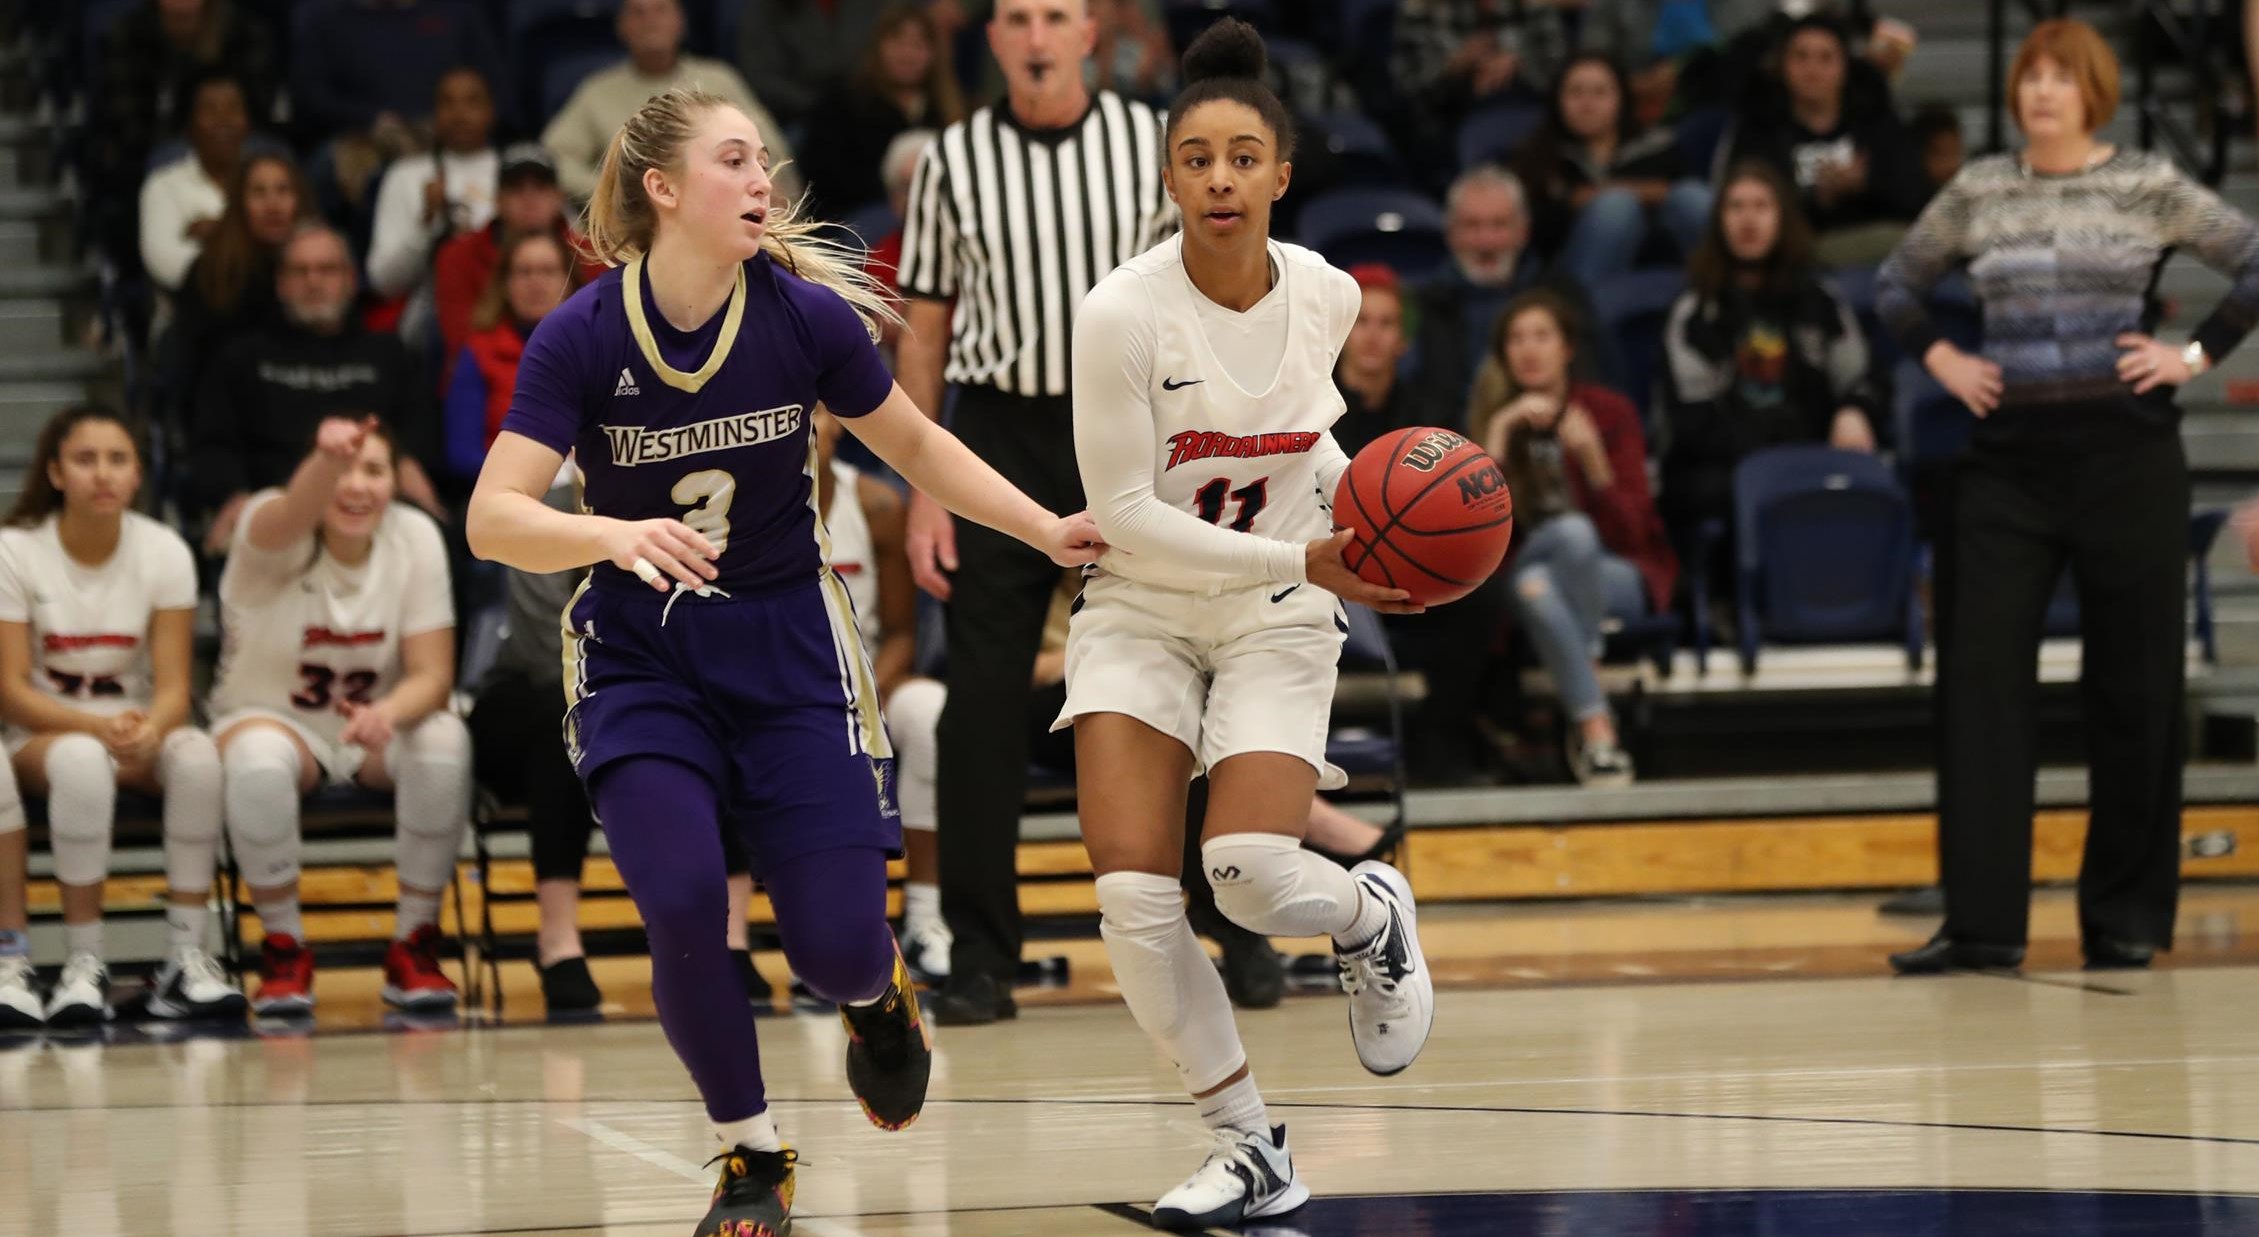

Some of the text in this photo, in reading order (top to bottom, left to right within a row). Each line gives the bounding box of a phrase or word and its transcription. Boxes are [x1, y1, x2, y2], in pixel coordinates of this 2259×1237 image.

[601, 404, 802, 466] WESTMINSTER
[671, 469, 736, 558] 3
[1193, 476, 1269, 533] 11
[291, 663, 379, 708] 32
